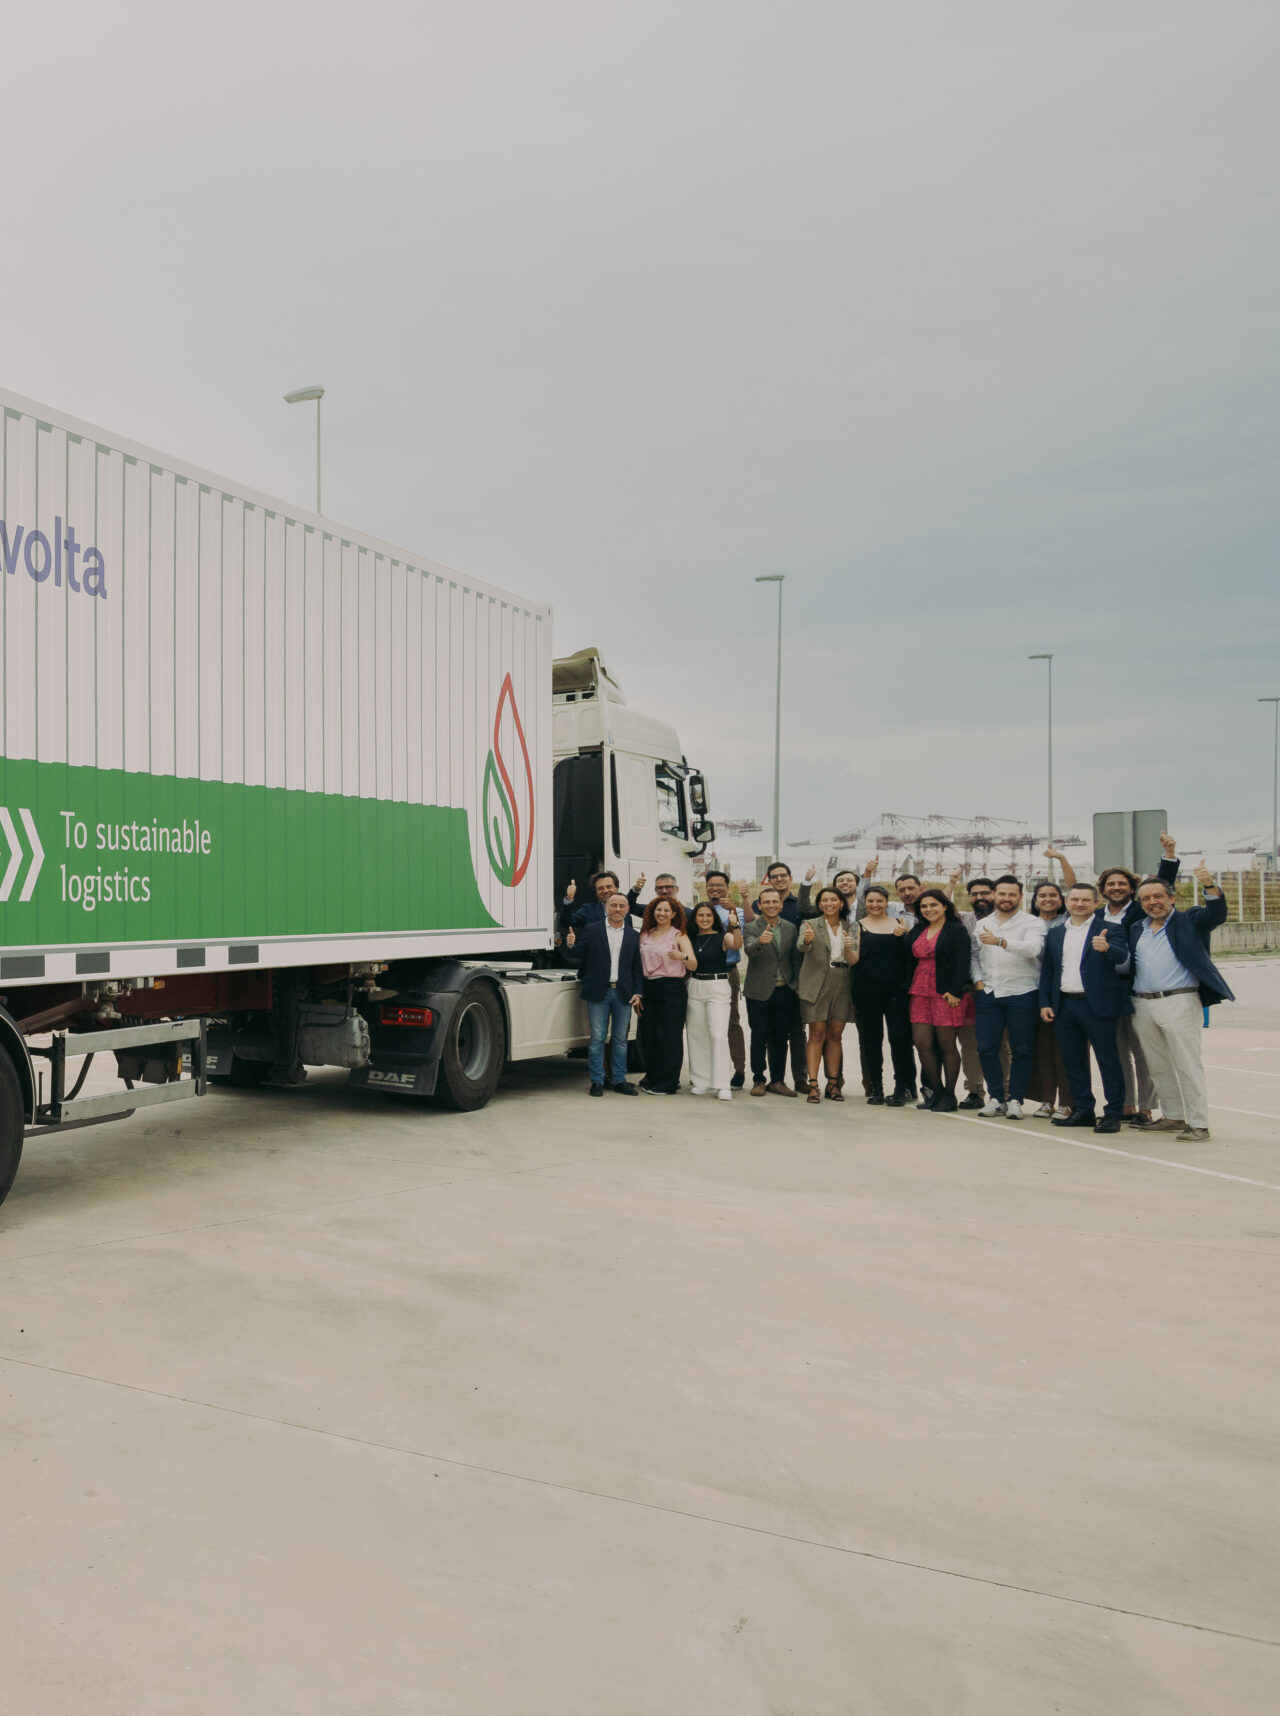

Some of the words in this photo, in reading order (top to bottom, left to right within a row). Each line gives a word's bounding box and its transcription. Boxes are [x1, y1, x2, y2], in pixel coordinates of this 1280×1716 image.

[59, 810, 88, 848] To
[95, 818, 212, 855] sustainable
[59, 863, 151, 912] logistics
[181, 1053, 218, 1064] DF
[367, 1070, 416, 1083] DAF
